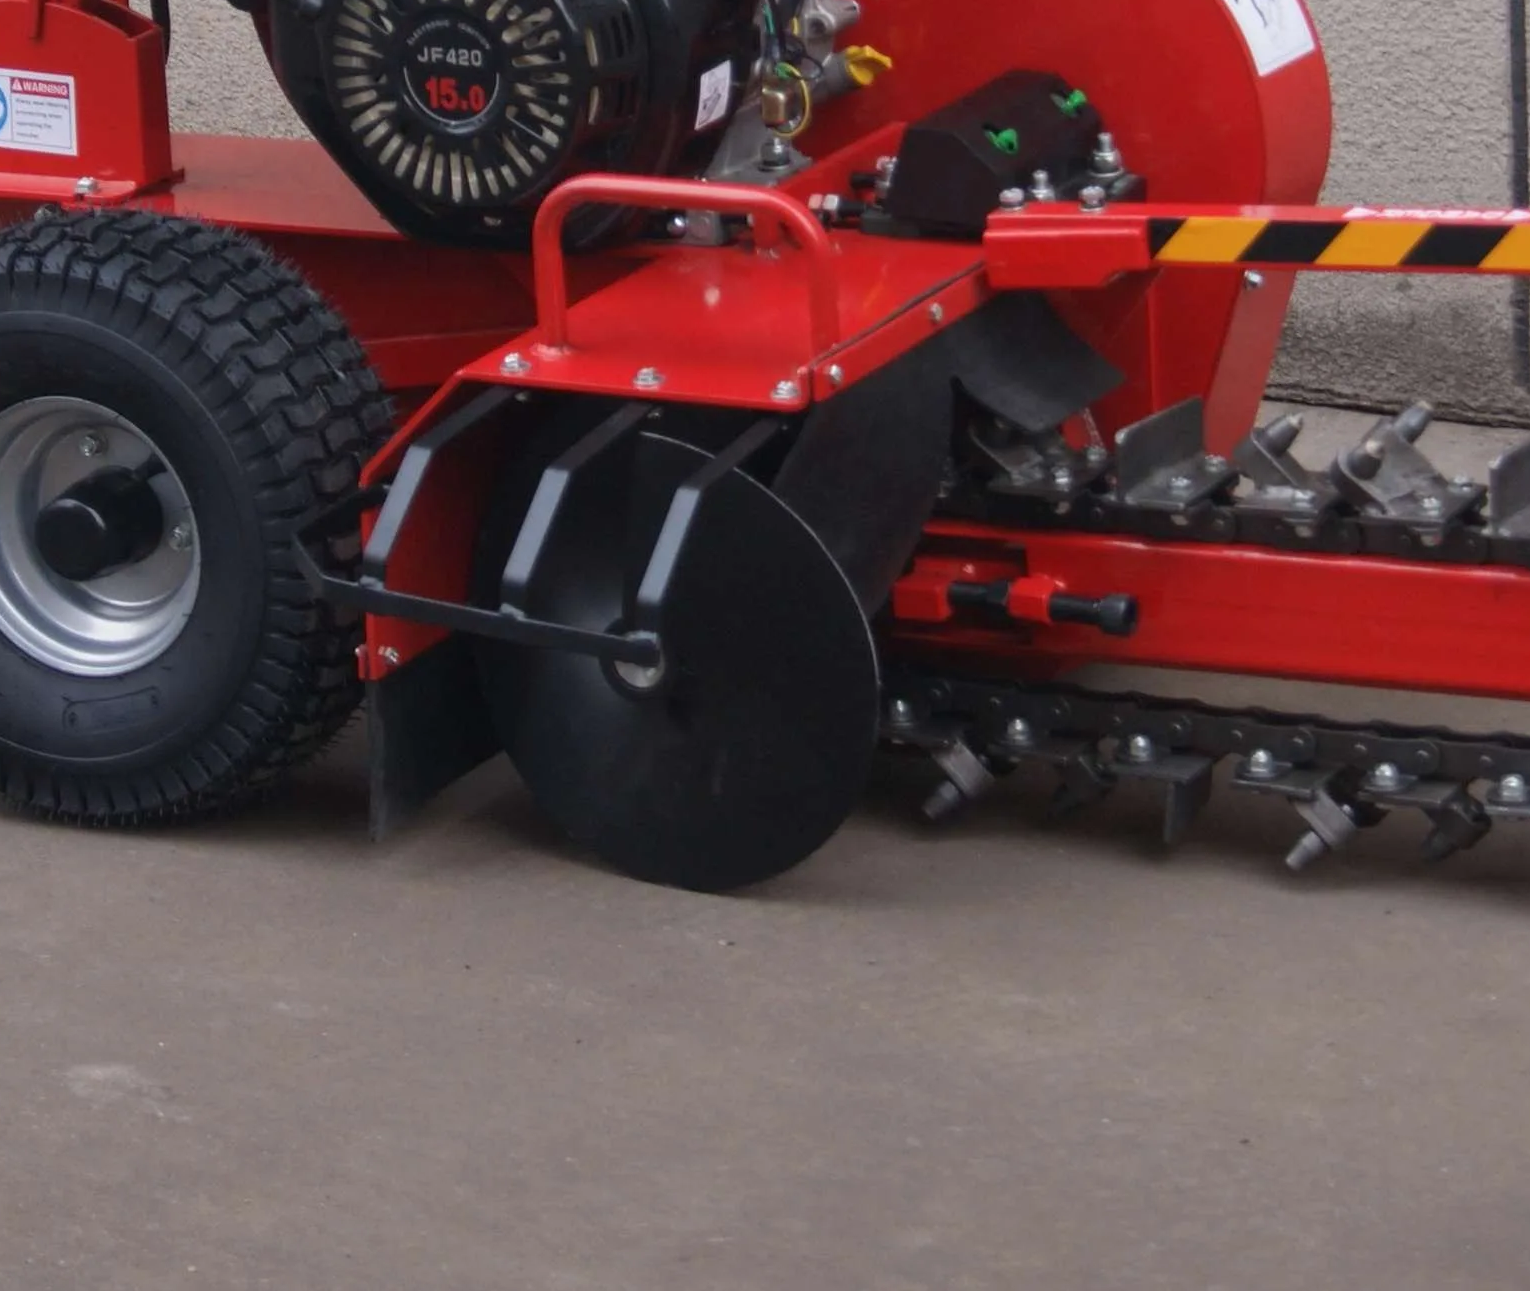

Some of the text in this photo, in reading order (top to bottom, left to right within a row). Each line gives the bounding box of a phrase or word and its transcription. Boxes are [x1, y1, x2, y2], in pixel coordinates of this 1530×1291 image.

[417, 46, 482, 67] JF420
[22, 81, 68, 96] WARNING
[425, 75, 486, 113] 15.0
